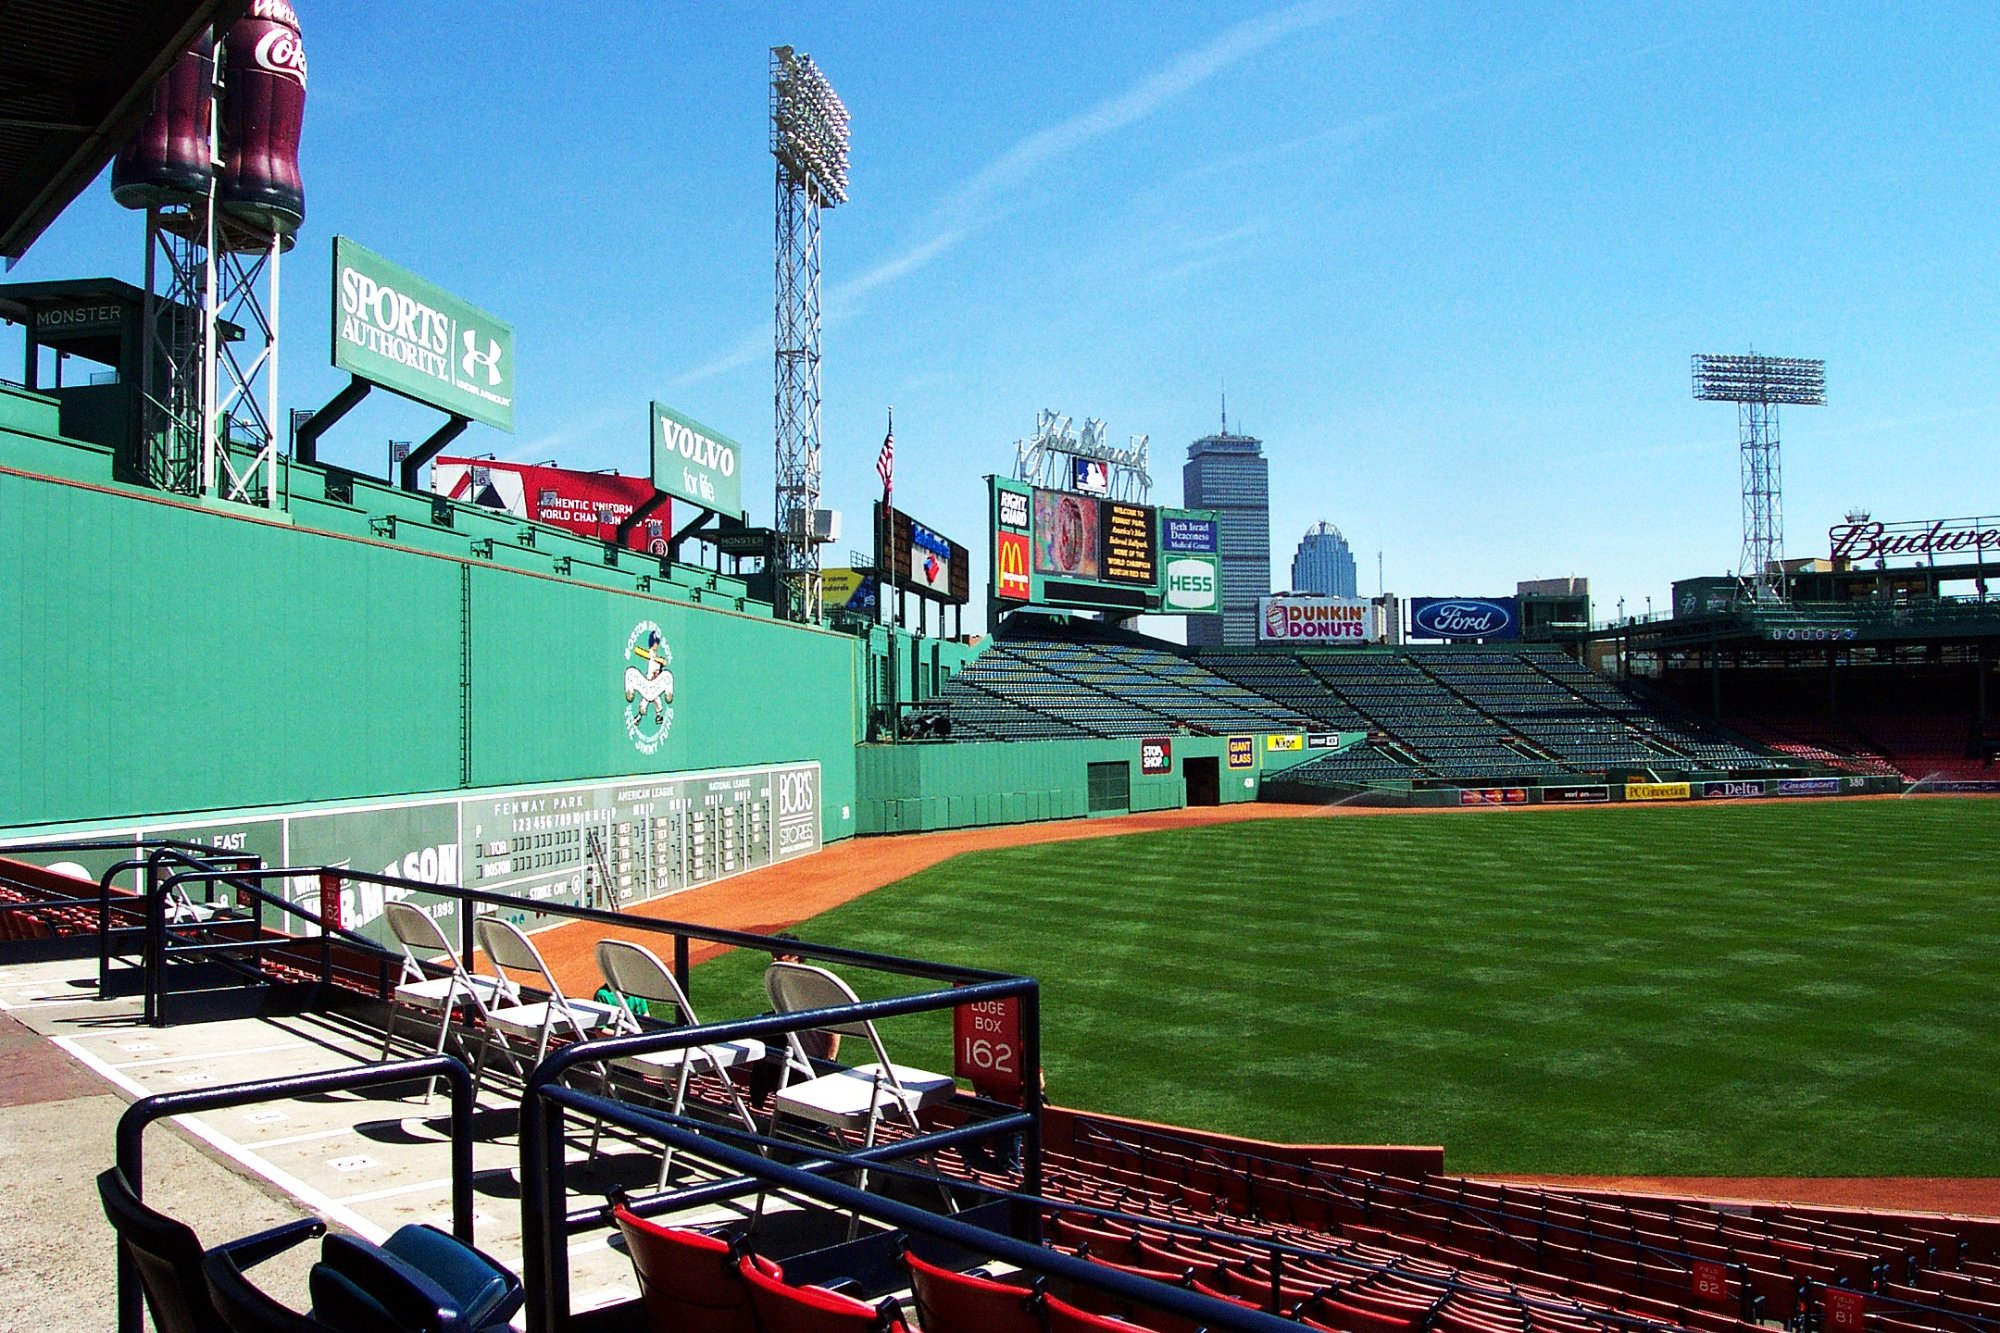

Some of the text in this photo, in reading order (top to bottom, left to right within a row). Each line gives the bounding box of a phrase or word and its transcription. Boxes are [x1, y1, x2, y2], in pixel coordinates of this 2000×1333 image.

[37, 305, 122, 326] MONSTER
[342, 266, 448, 355] SPORTS
[341, 314, 449, 382] AUTHORITY
[660, 416, 735, 477] VOLVO
[683, 466, 699, 495] for
[537, 497, 634, 514] HENTIC UNIFORM
[1001, 491, 1028, 512] RIGHT
[537, 508, 571, 520] WORLD
[1000, 506, 1028, 527] GUARD
[1170, 522, 1209, 532] Beth Israel
[1171, 531, 1209, 541] Deaconess
[1829, 521, 2000, 562] Budwe
[1170, 575, 1213, 592] HESS
[1289, 606, 1367, 621] DUNKIN'
[1434, 604, 1491, 631] Ford
[1289, 621, 1364, 637] DONUTS
[1230, 741, 1251, 753] GIANT
[1275, 738, 1295, 749] Nikon
[1230, 754, 1252, 764] GLASS
[617, 786, 675, 801] AMERICAN LEAGUE
[1642, 784, 1686, 797] Connection
[1724, 782, 1759, 795] Delta
[494, 795, 583, 816] FENWAY PARK
[475, 825, 483, 839] P
[779, 822, 813, 846] STORES
[213, 832, 247, 850] EAST
[489, 841, 507, 856] TOR
[484, 860, 511, 878] BOSTON
[529, 884, 553, 901] STRIKE
[553, 880, 568, 896] OUT
[432, 901, 454, 919] 1898
[971, 1000, 1005, 1016] LOGE
[975, 1017, 1002, 1033] BOX
[966, 1037, 1013, 1073] 162
[1700, 1266, 1718, 1275] FIELD
[1699, 1280, 1719, 1295] 82
[1834, 1295, 1855, 1304] FIELD
[1838, 1302, 1852, 1310] BOX
[1835, 1311, 1852, 1324] 81
